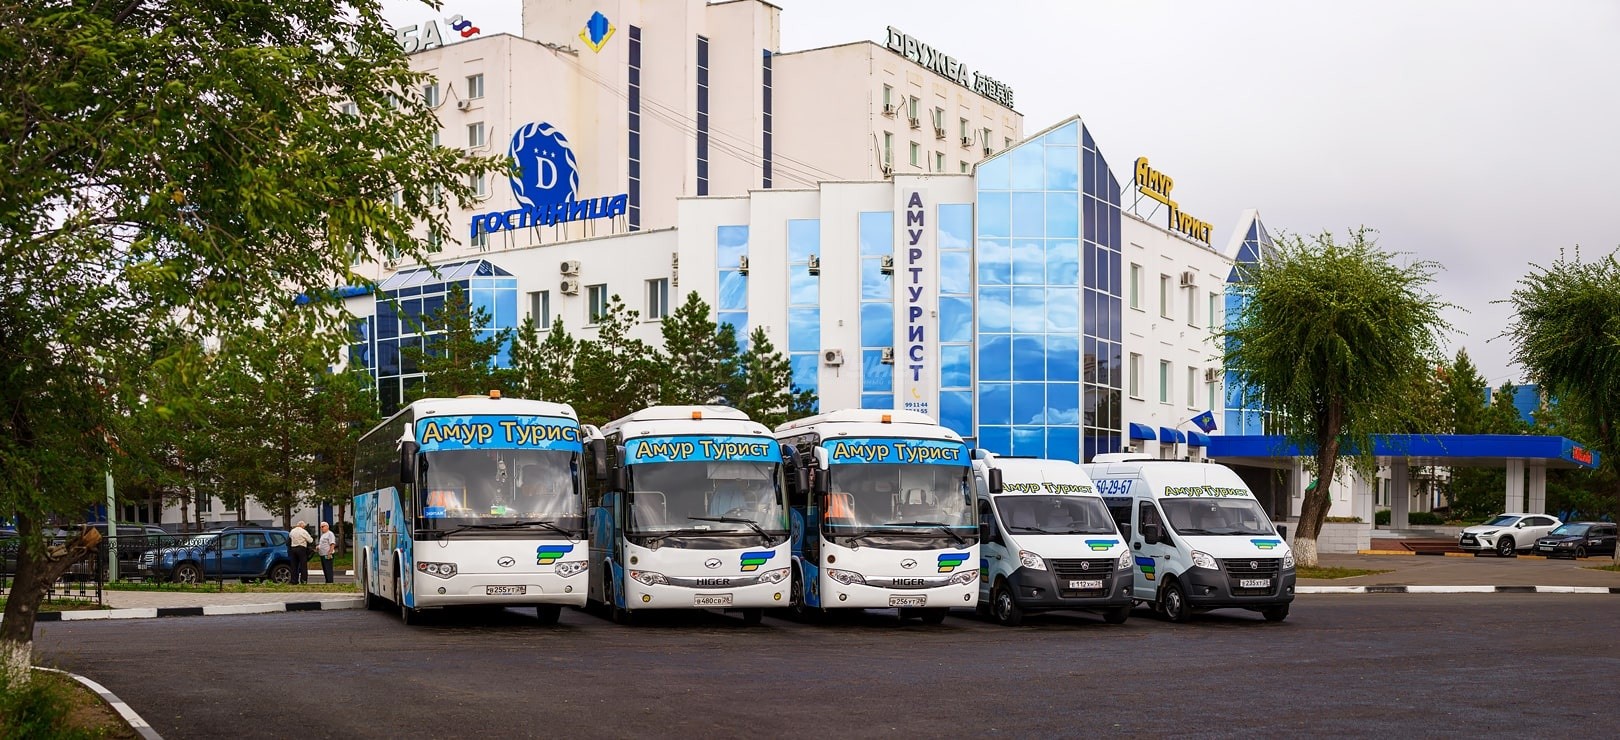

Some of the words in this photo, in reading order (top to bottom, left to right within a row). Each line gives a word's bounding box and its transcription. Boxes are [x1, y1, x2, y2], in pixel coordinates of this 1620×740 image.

[536, 156, 558, 190] D
[906, 191, 925, 382] АМУРТУРИСТ
[422, 420, 493, 446] Амур
[499, 420, 582, 446] Турист
[636, 440, 694, 460] Амур
[699, 440, 770, 460] Турист
[833, 442, 890, 461] Амур
[894, 443, 960, 463] Турист
[1001, 481, 1040, 493] Амур
[1044, 482, 1092, 494] Турист
[1164, 485, 1204, 497] Амур
[1204, 485, 1249, 497] Турист
[696, 577, 730, 586] HIGER
[892, 578, 925, 586] HIGER
